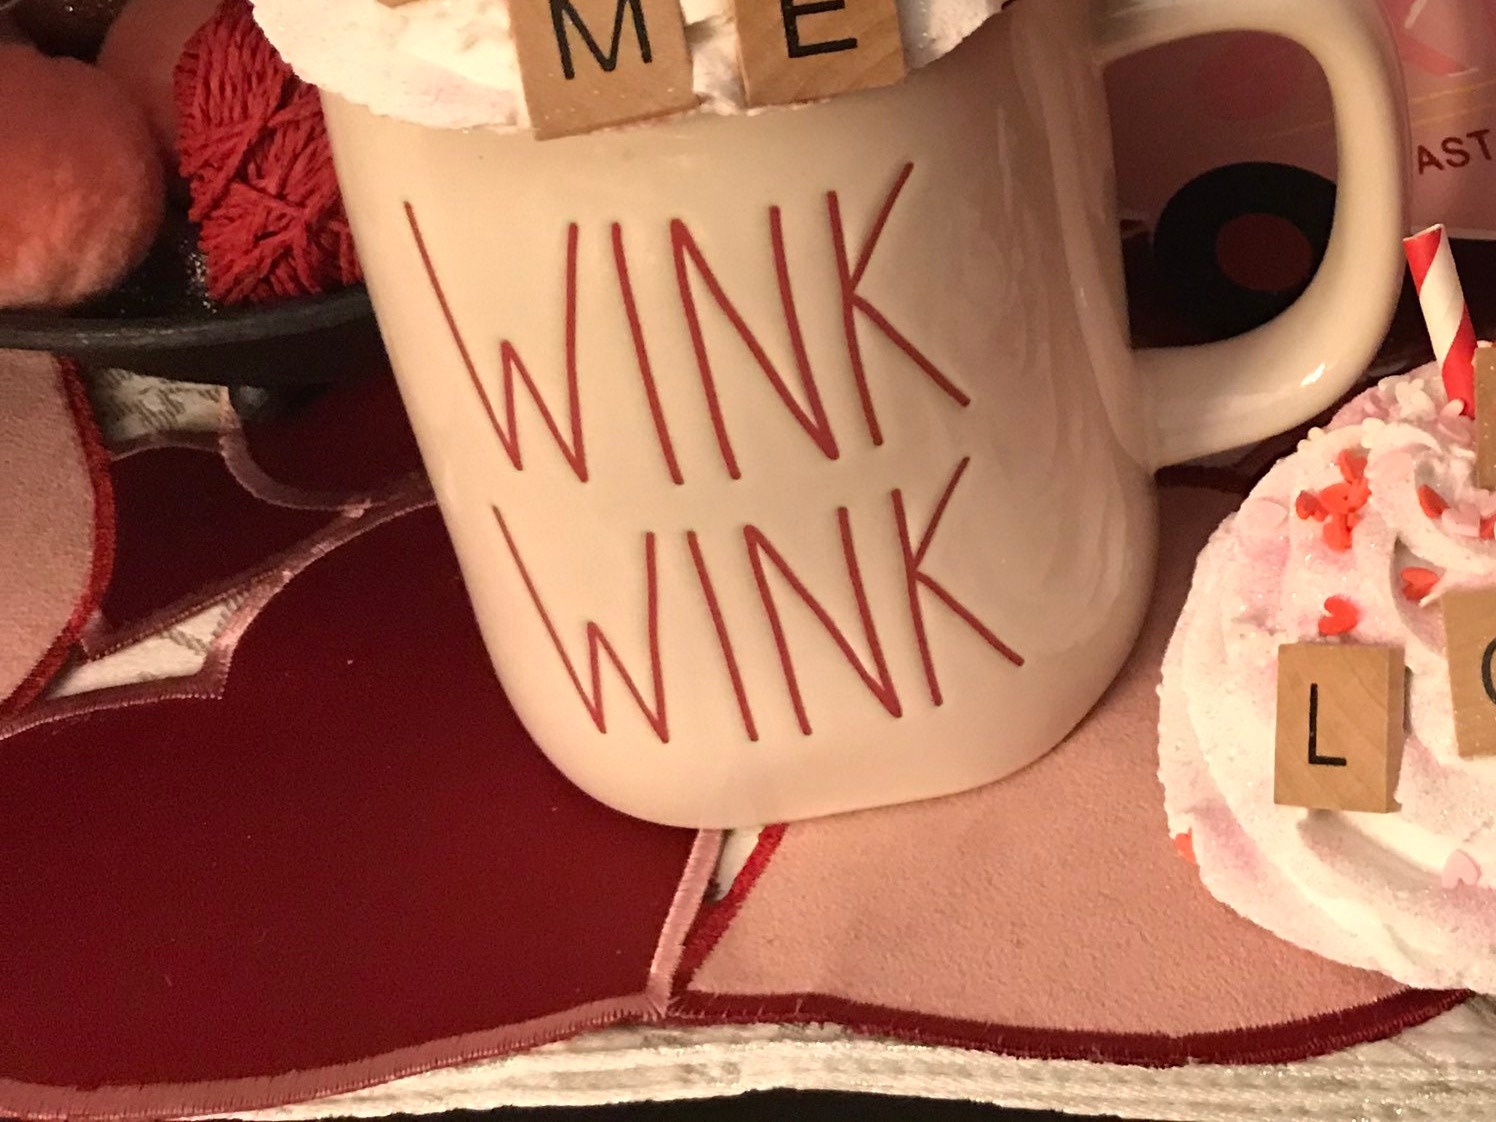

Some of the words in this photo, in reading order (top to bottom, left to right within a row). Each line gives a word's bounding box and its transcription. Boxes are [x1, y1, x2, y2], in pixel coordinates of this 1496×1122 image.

[1416, 128, 1493, 175] AST
[403, 162, 971, 485] WINK
[491, 457, 1025, 743] WINK
